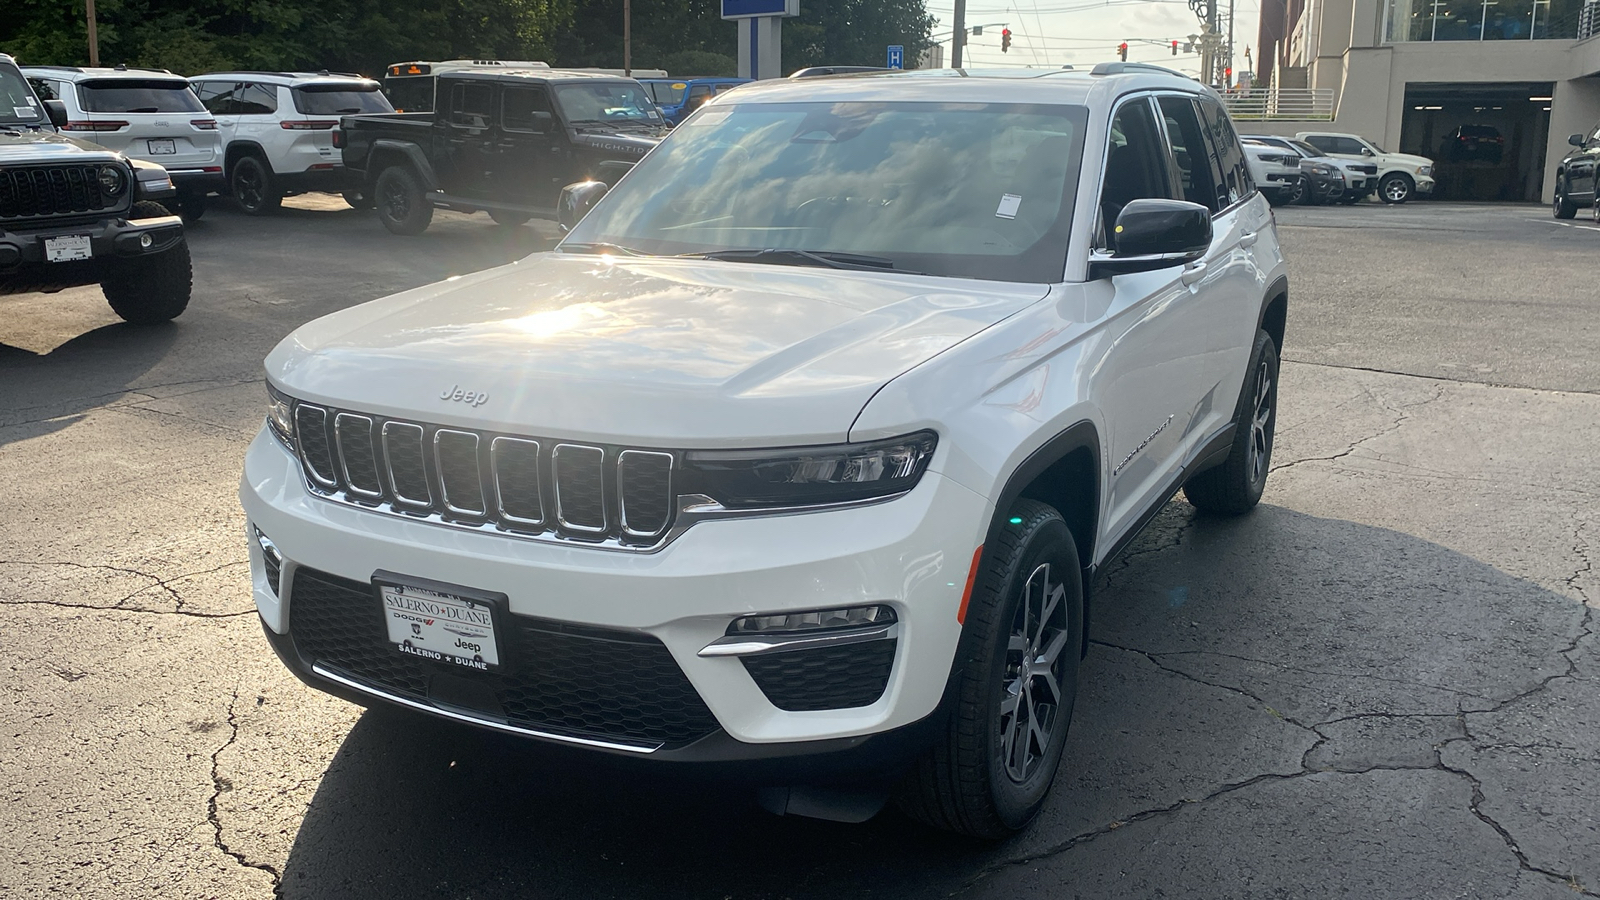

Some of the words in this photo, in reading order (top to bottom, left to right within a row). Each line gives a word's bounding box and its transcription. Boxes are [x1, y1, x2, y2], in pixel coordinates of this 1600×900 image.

[891, 51, 900, 64] H
[439, 384, 489, 408] Jeep
[386, 595, 440, 615] SALERNO
[446, 607, 491, 626] DUANE
[393, 612, 427, 623] DODGE
[454, 638, 481, 653] Jeep
[398, 644, 441, 660] SALERNO
[455, 657, 488, 670] DUANE
